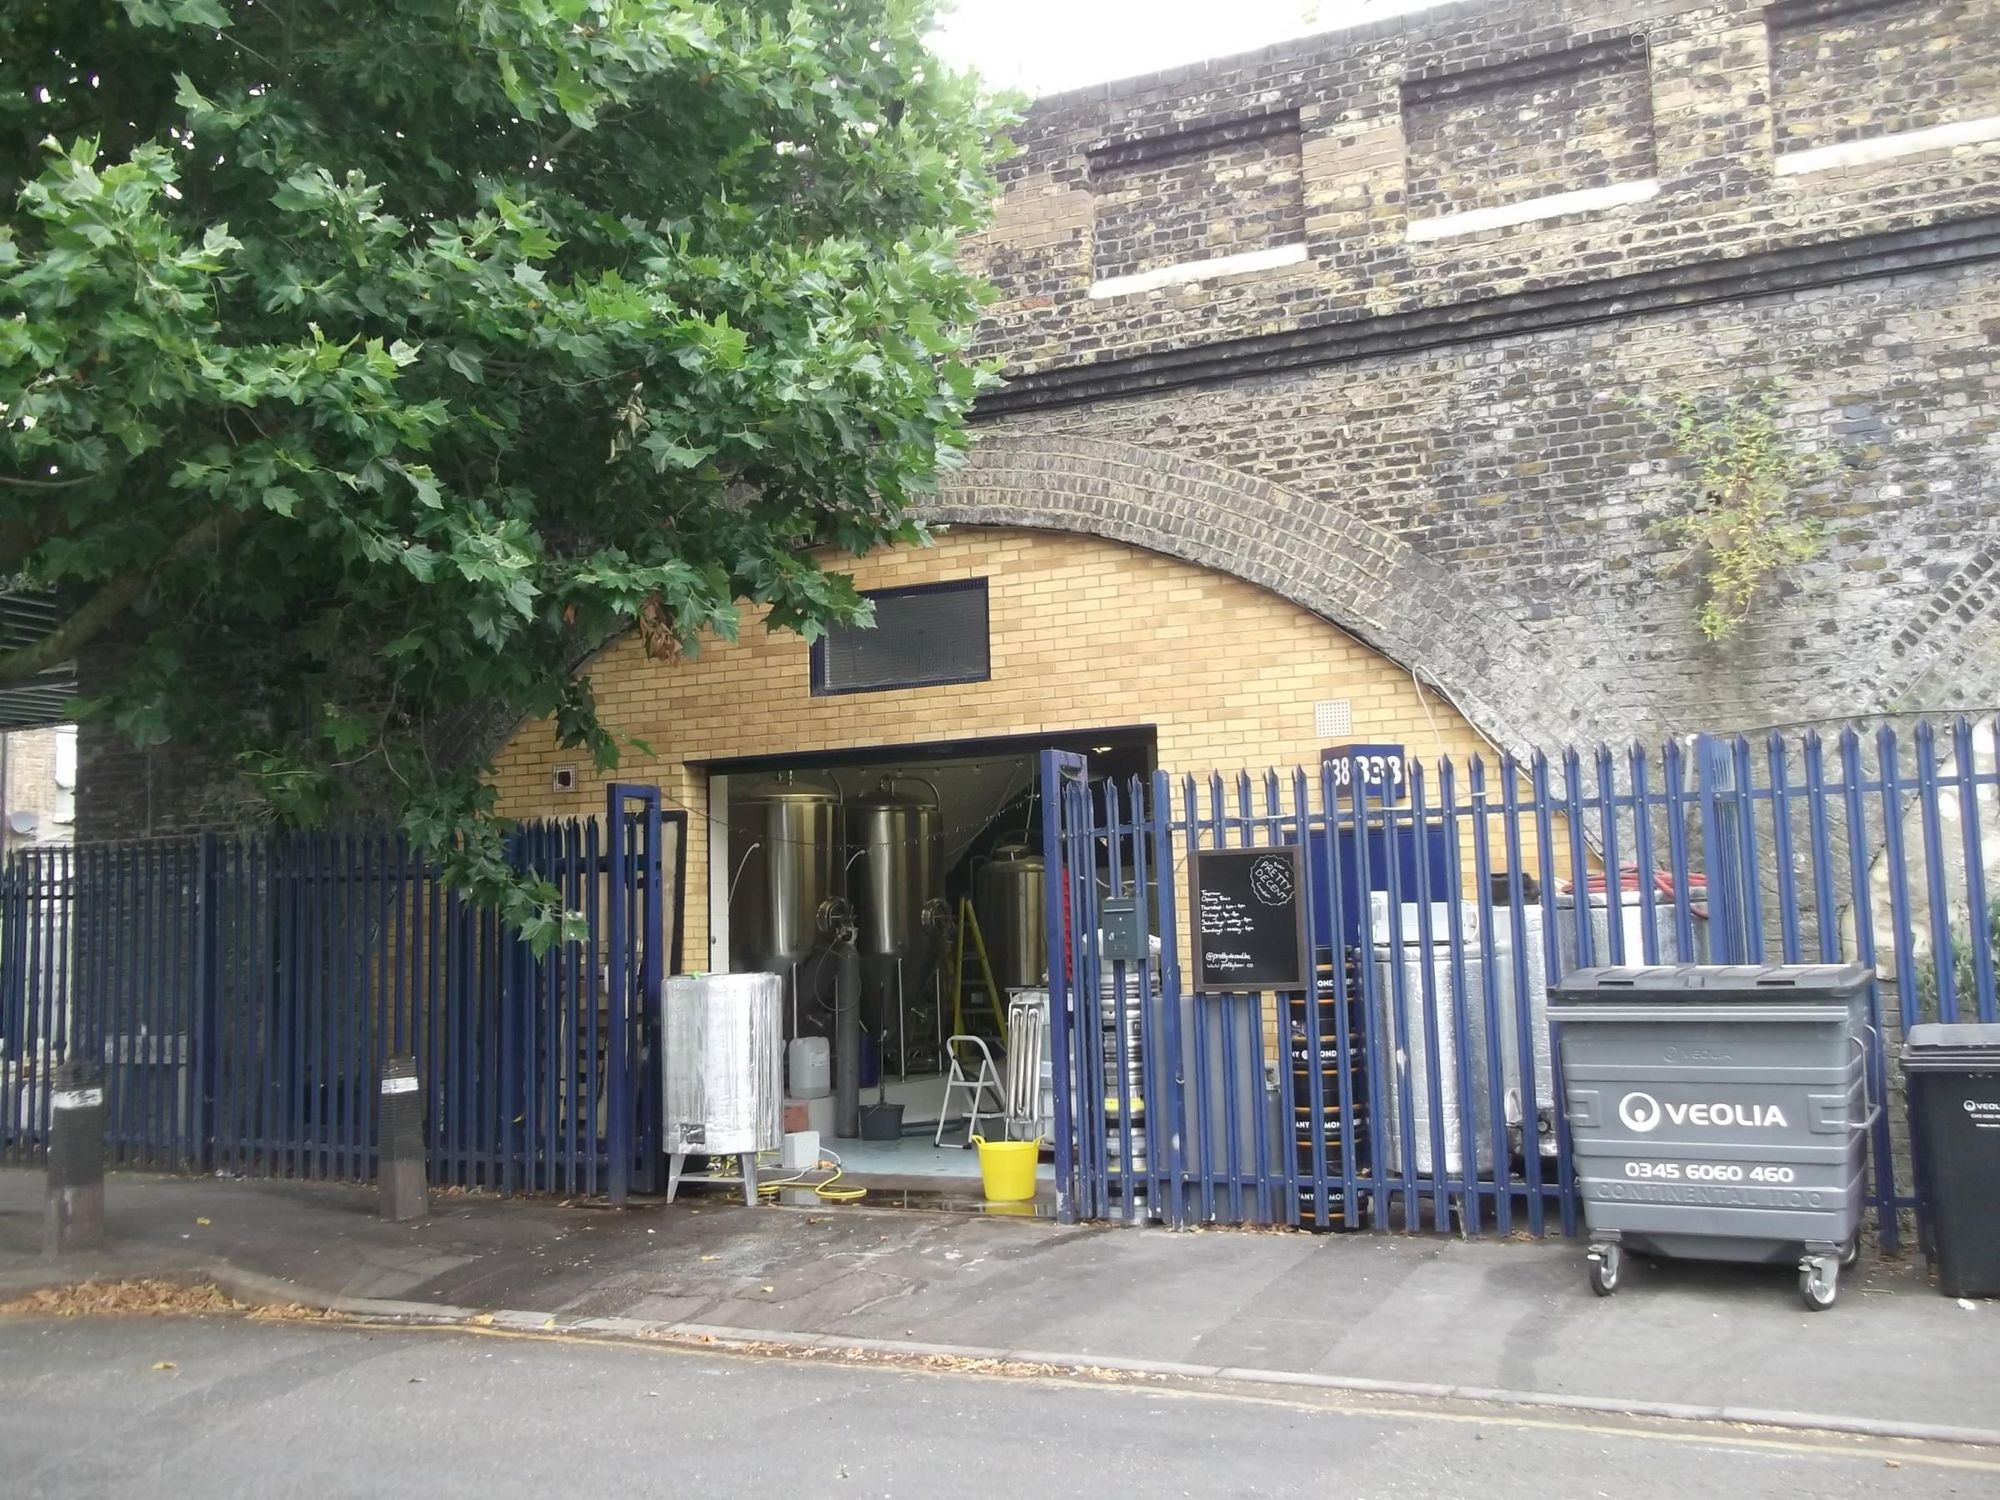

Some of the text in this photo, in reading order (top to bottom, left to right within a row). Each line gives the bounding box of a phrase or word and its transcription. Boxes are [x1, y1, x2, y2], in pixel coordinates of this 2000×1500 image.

[1255, 868, 1288, 899] DECENT
[1260, 861, 1292, 890] PRETTY
[1664, 1103, 1788, 1127] VEOLIA
[1625, 1162, 1794, 1183] 0345 6060 460
